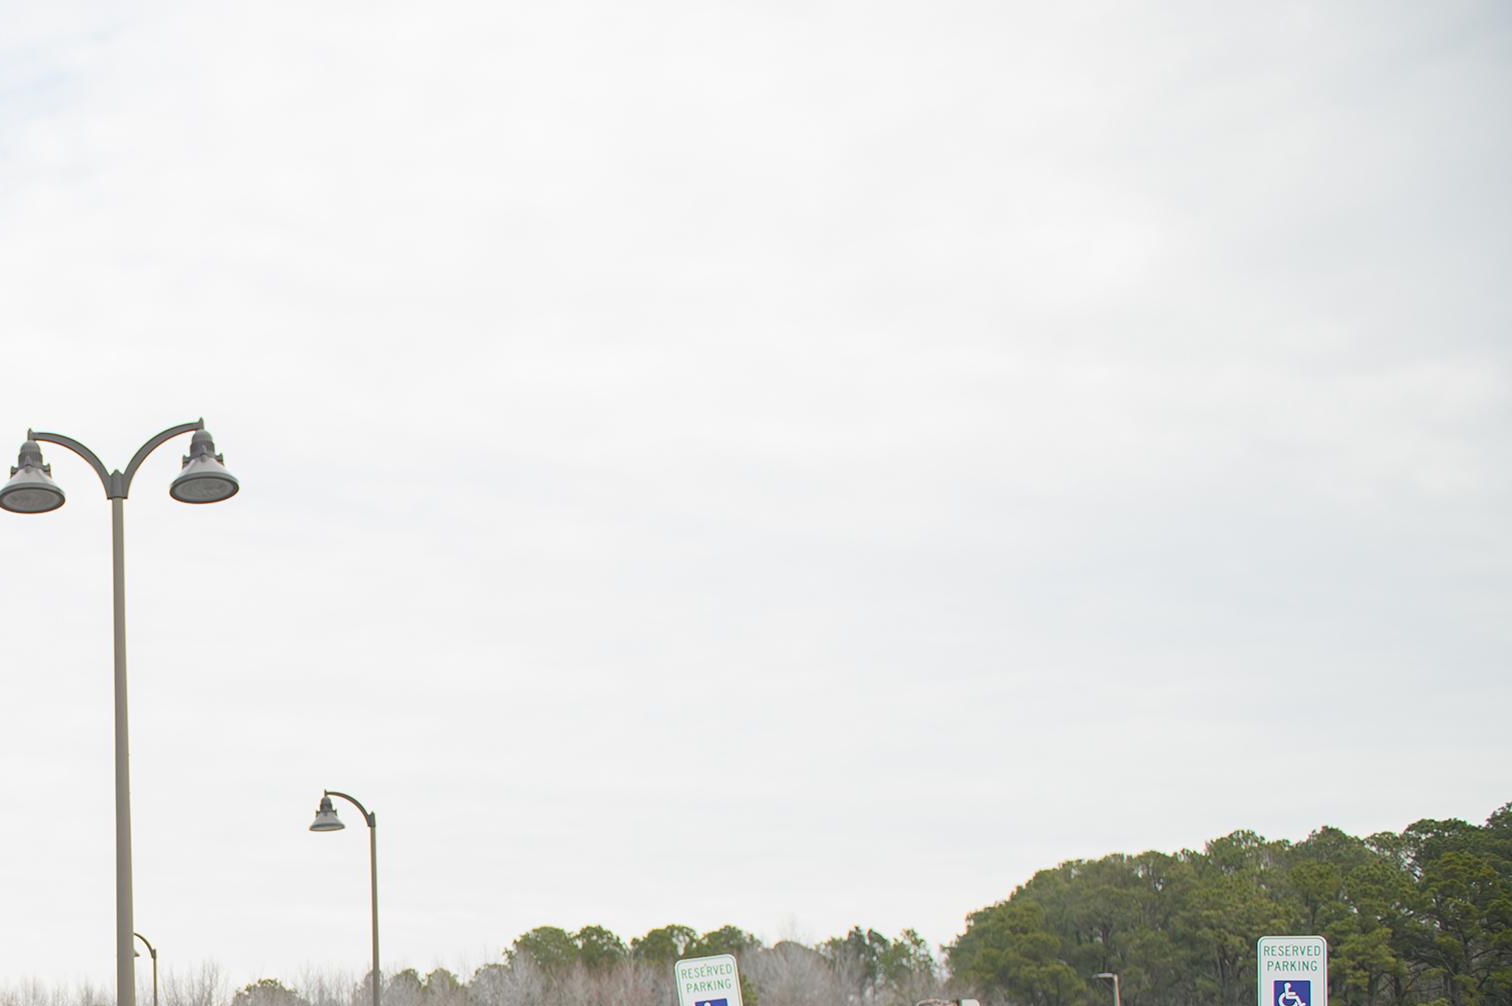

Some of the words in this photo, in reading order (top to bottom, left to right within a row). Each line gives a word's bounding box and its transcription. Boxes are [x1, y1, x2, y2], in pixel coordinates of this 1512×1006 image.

[1263, 945, 1321, 957] RESERVED
[681, 964, 732, 979] RESERVED
[1267, 960, 1318, 972] PARKING
[687, 979, 732, 992] PARKING
